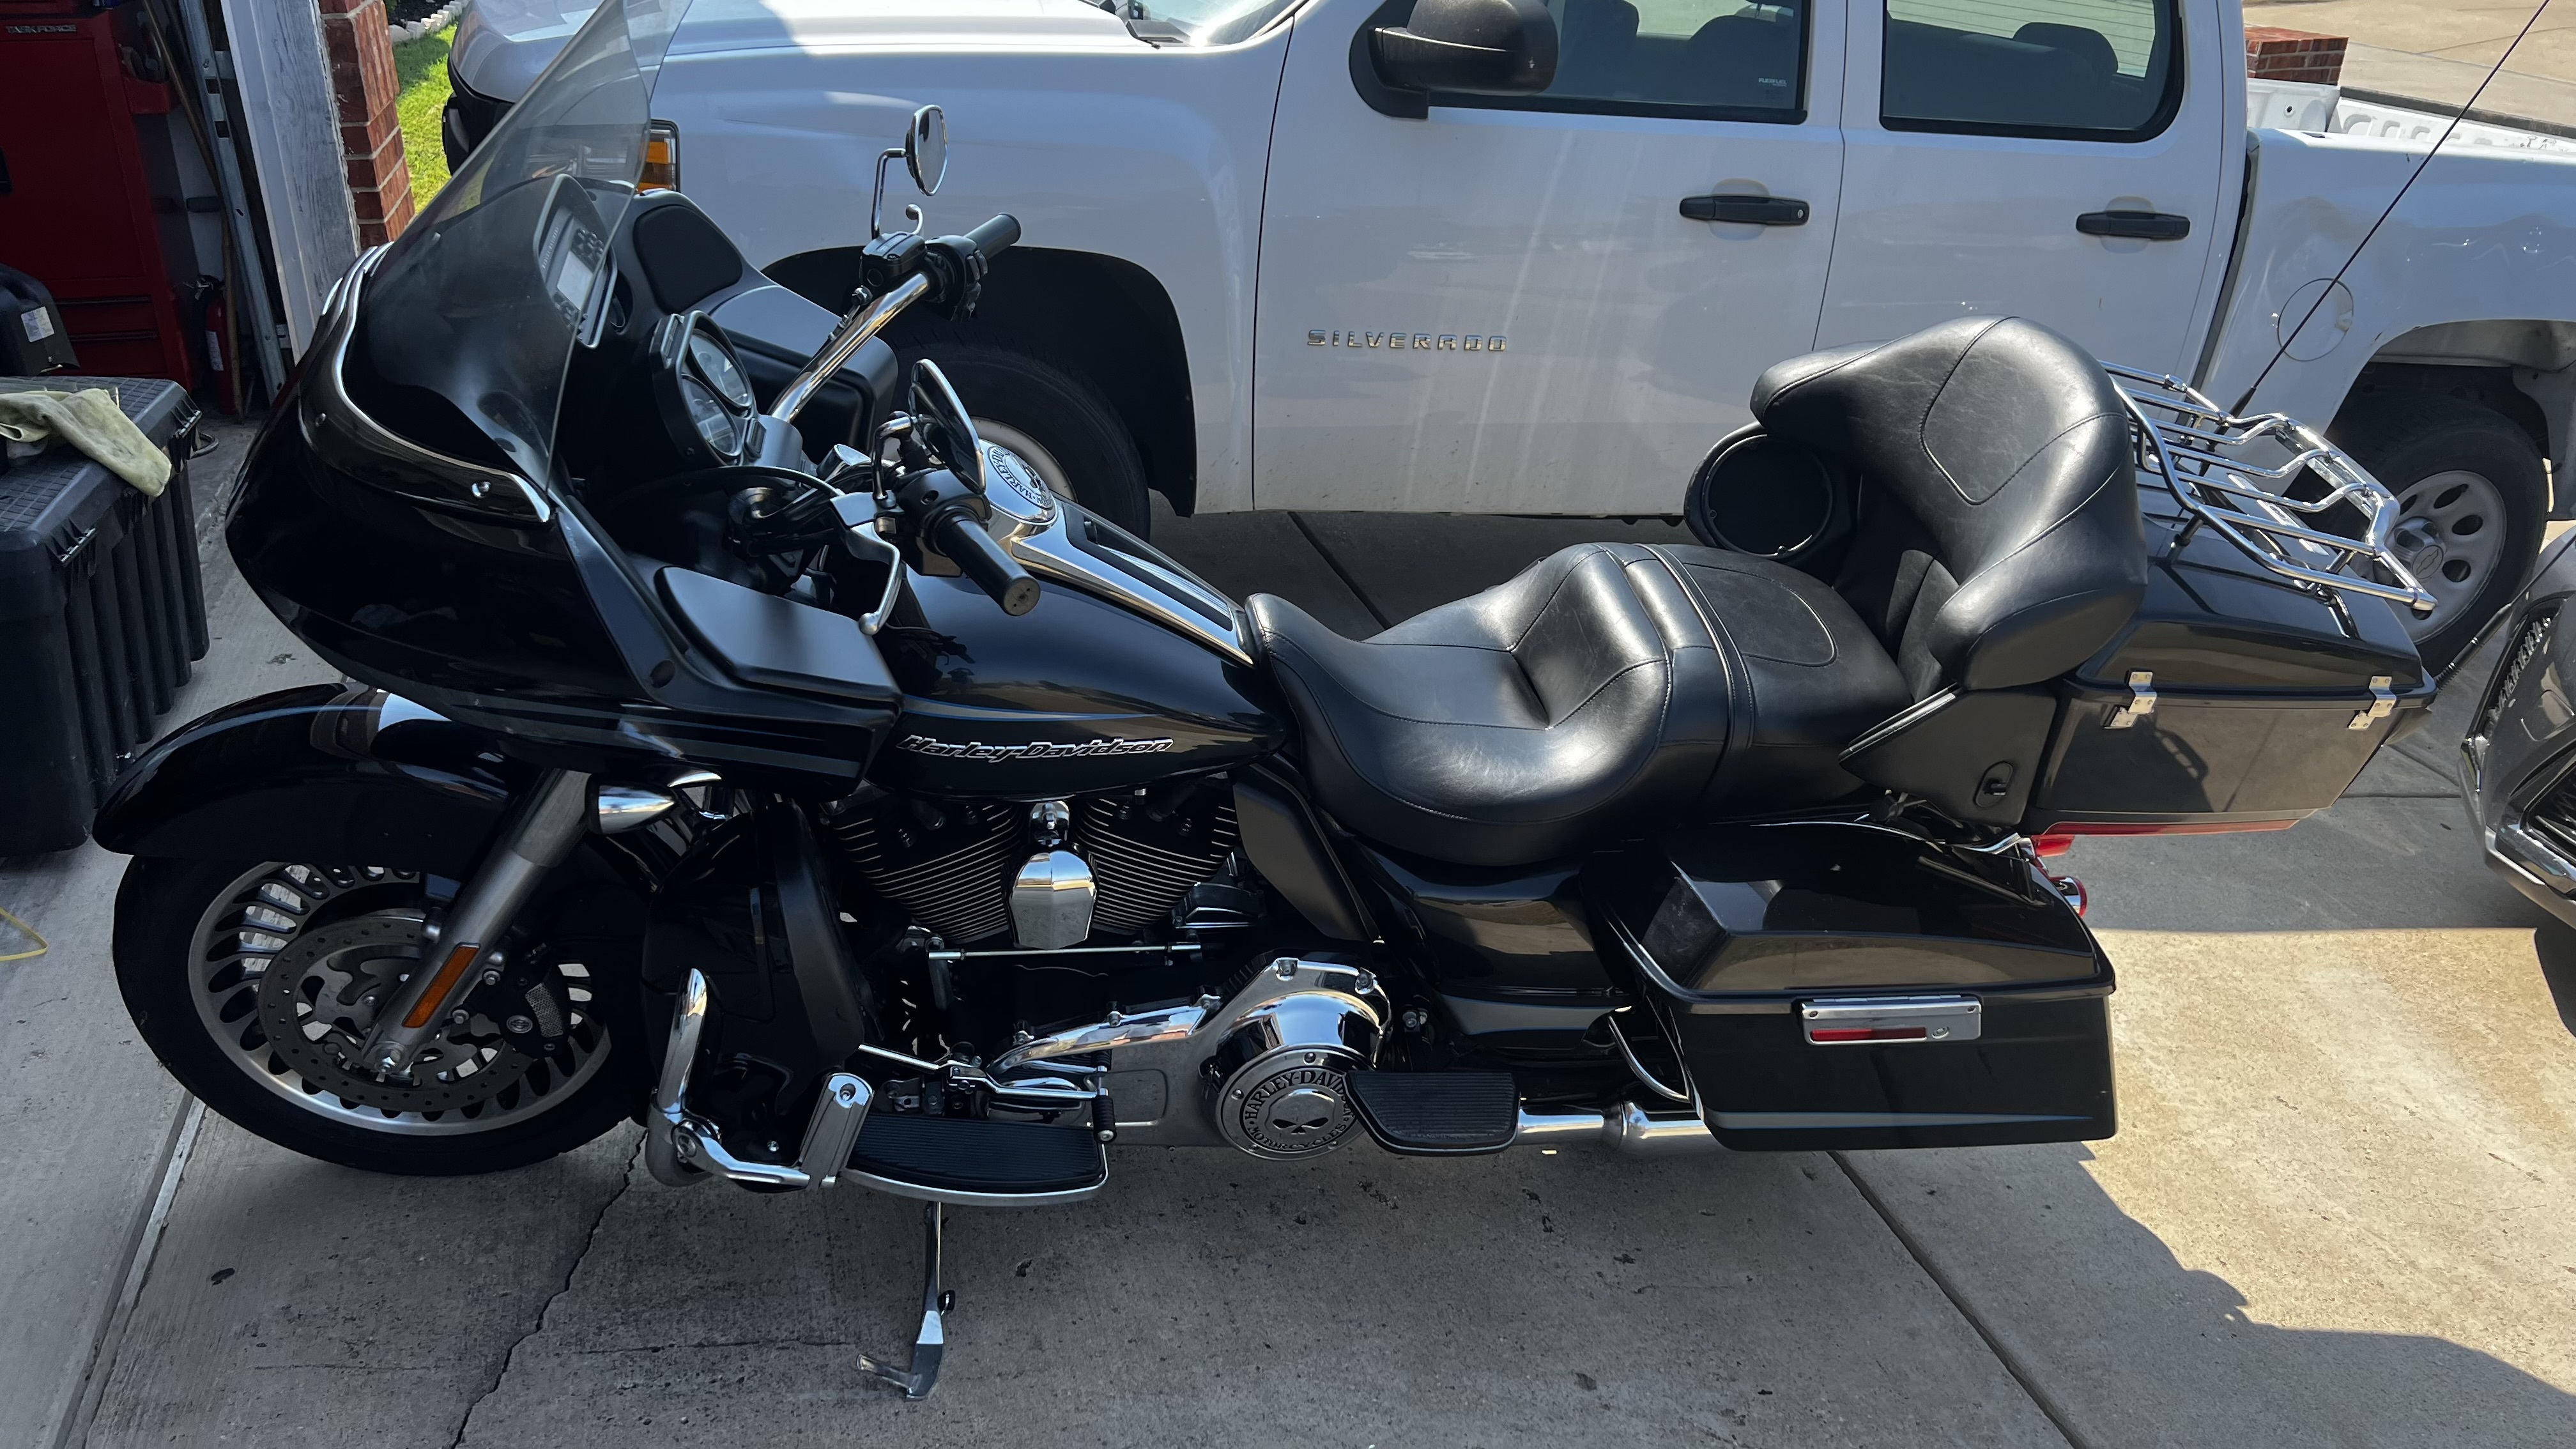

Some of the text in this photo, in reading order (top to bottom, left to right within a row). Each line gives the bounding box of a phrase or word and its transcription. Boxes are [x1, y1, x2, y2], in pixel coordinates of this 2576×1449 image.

[1308, 330, 1507, 351] SILVERADO
[896, 735, 1174, 762] Harley-Davidson
[1247, 1123, 1347, 1149] MOTORCYCLES
